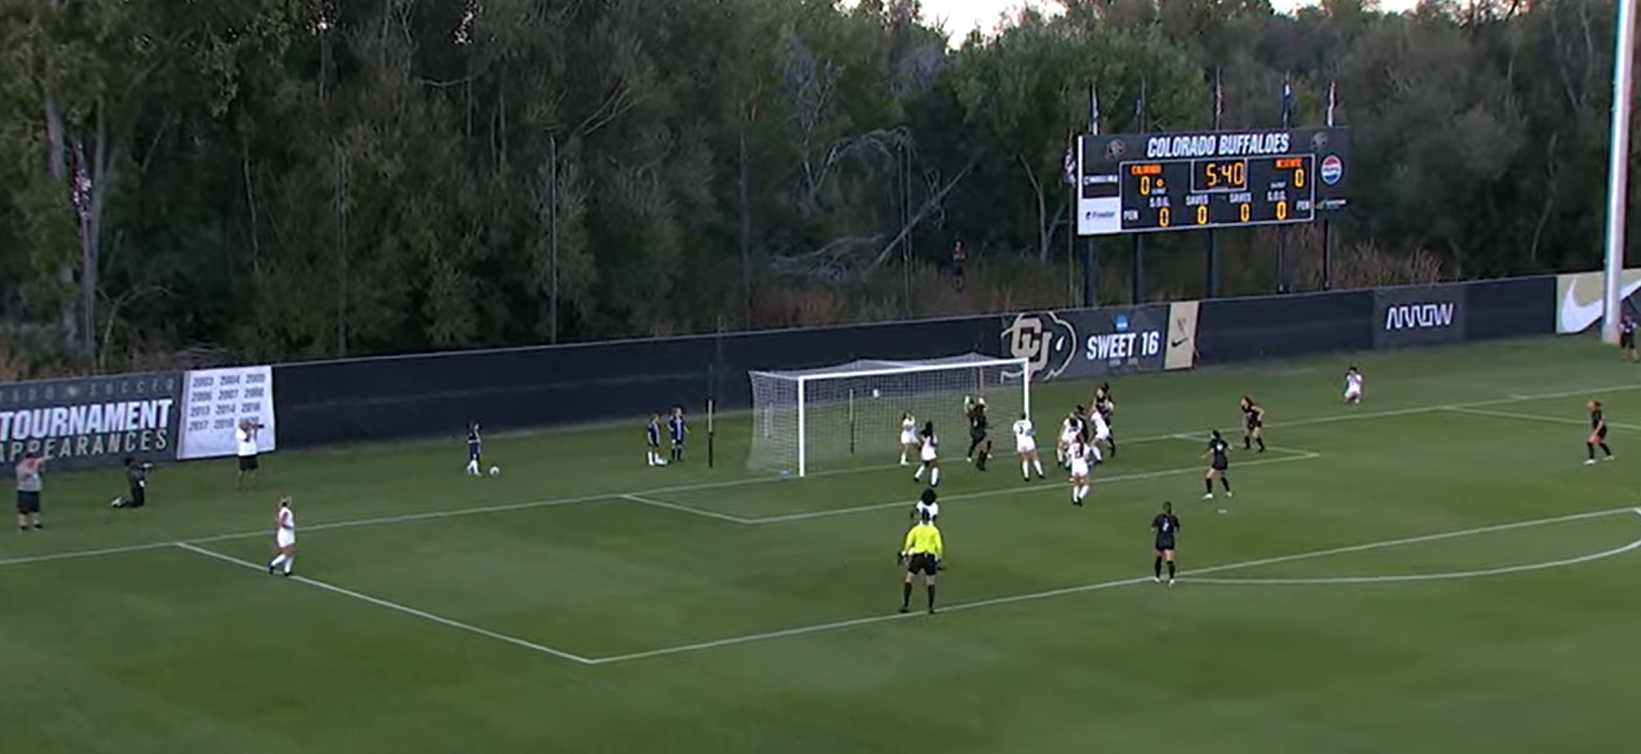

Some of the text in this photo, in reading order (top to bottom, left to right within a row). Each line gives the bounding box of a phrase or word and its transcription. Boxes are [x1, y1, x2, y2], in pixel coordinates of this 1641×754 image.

[1147, 133, 1290, 158] COLORADO BUFFALOES
[1206, 162, 1244, 187] 5:40
[1294, 168, 1304, 188] 0
[1140, 175, 1150, 195] 0
[1159, 207, 1169, 227] 0
[1197, 205, 1207, 225] 0
[1240, 203, 1250, 222] 0
[1276, 201, 1287, 220] 0
[1086, 331, 1160, 360] SWEET 16
[0, 399, 174, 442] TOURNAMENT
